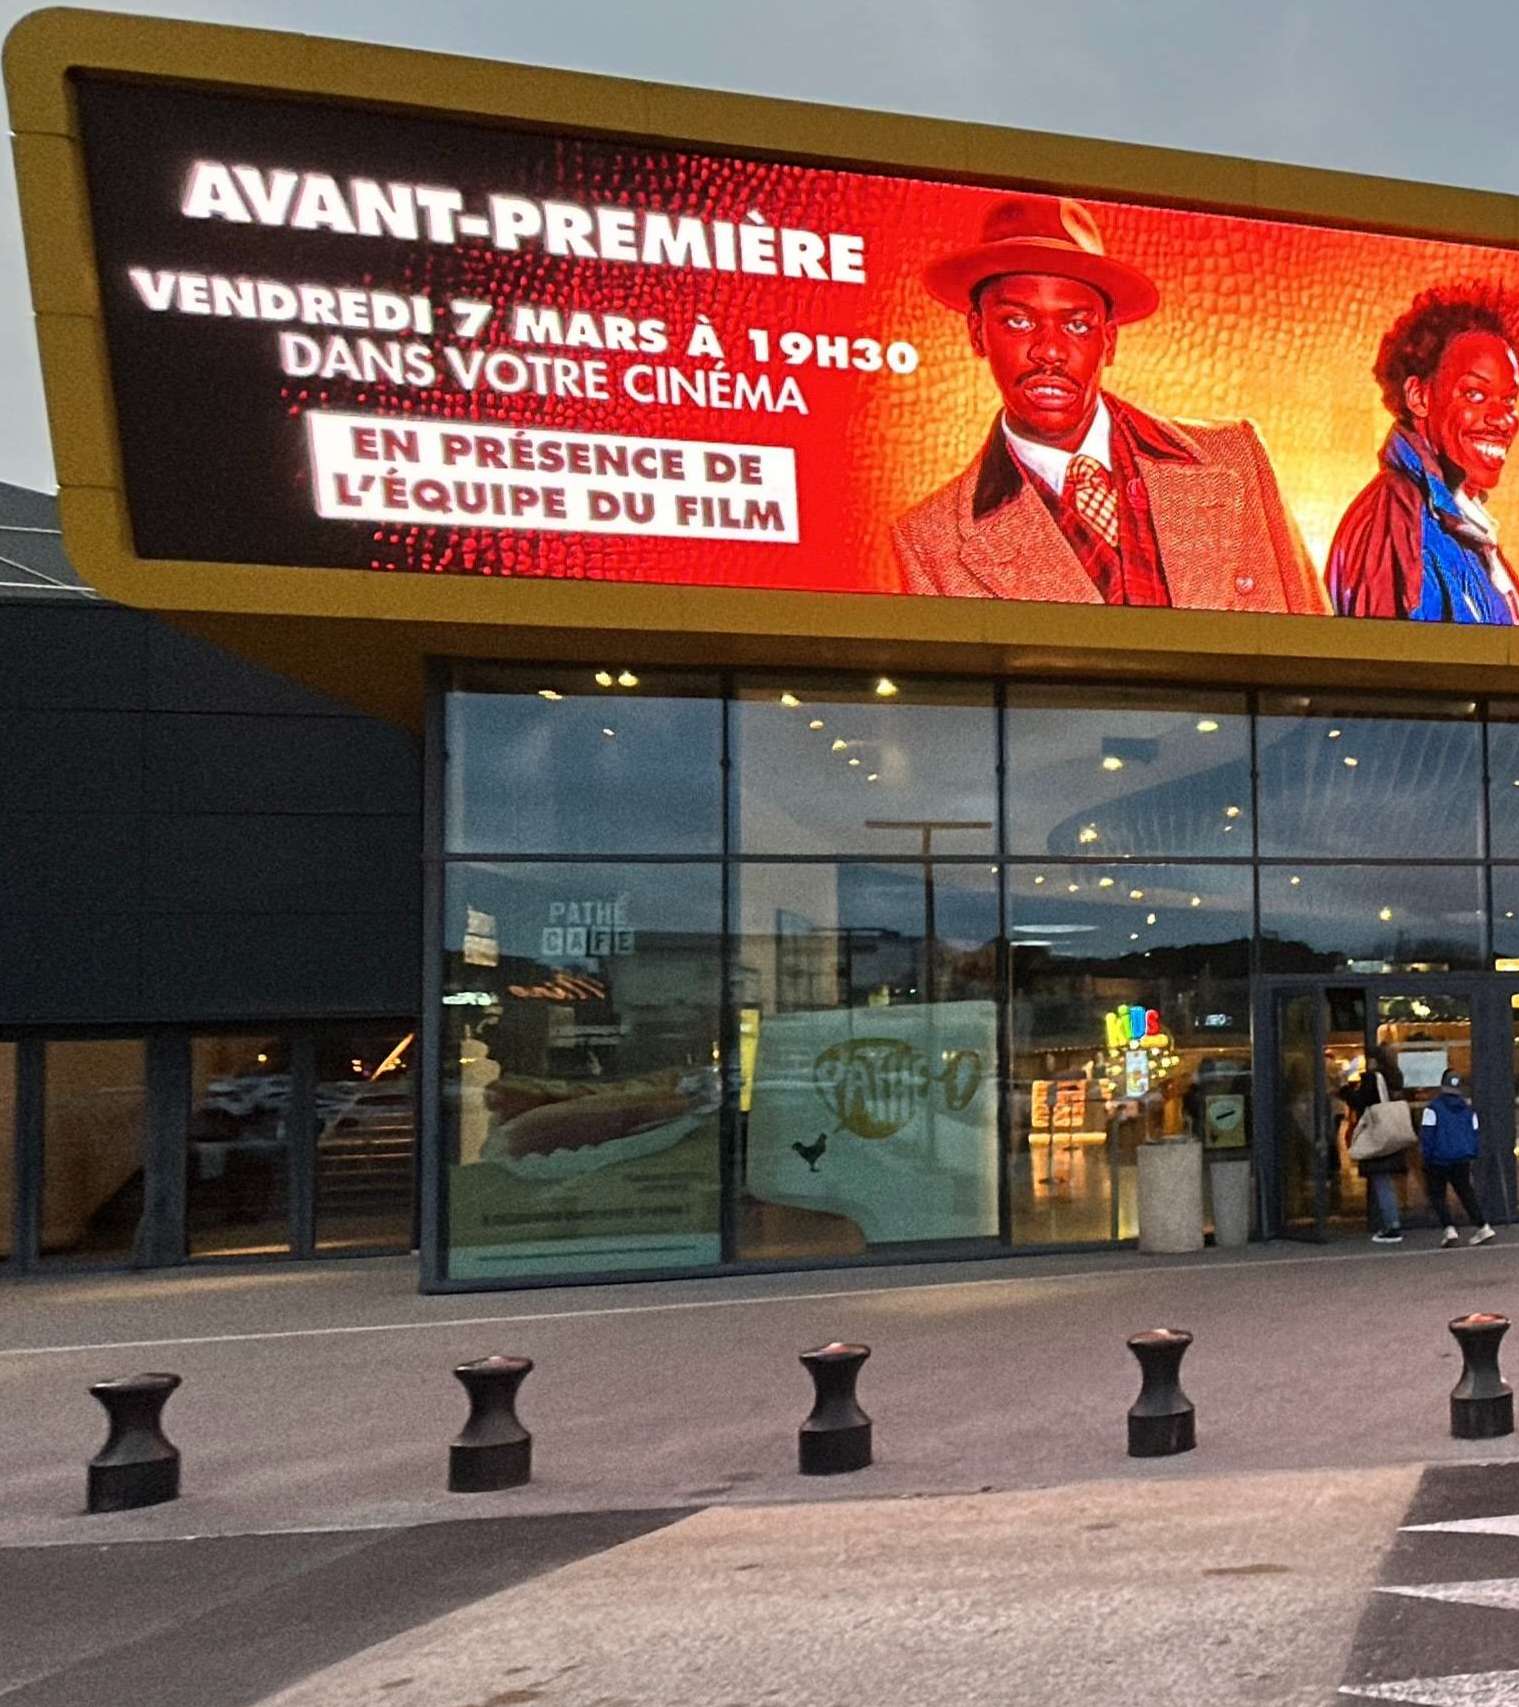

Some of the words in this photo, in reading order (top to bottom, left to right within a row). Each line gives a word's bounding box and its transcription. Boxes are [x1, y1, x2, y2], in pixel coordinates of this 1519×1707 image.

[181, 160, 866, 284] AVANT-PREMIÈRE
[129, 267, 432, 334] VENDREDI
[450, 300, 493, 336] 7
[514, 305, 668, 354] MARS
[687, 315, 724, 358] À
[748, 329, 919, 374] 19H30
[278, 331, 437, 386] DANS
[443, 345, 609, 401] VOTRE
[623, 360, 810, 415] CINÉMA
[350, 426, 420, 463] EN
[440, 431, 685, 480] PRÉSENCE
[704, 452, 763, 485] DE
[333, 467, 567, 515] L'ÉQUIPE
[587, 488, 656, 524] DU
[675, 494, 785, 532] FILM
